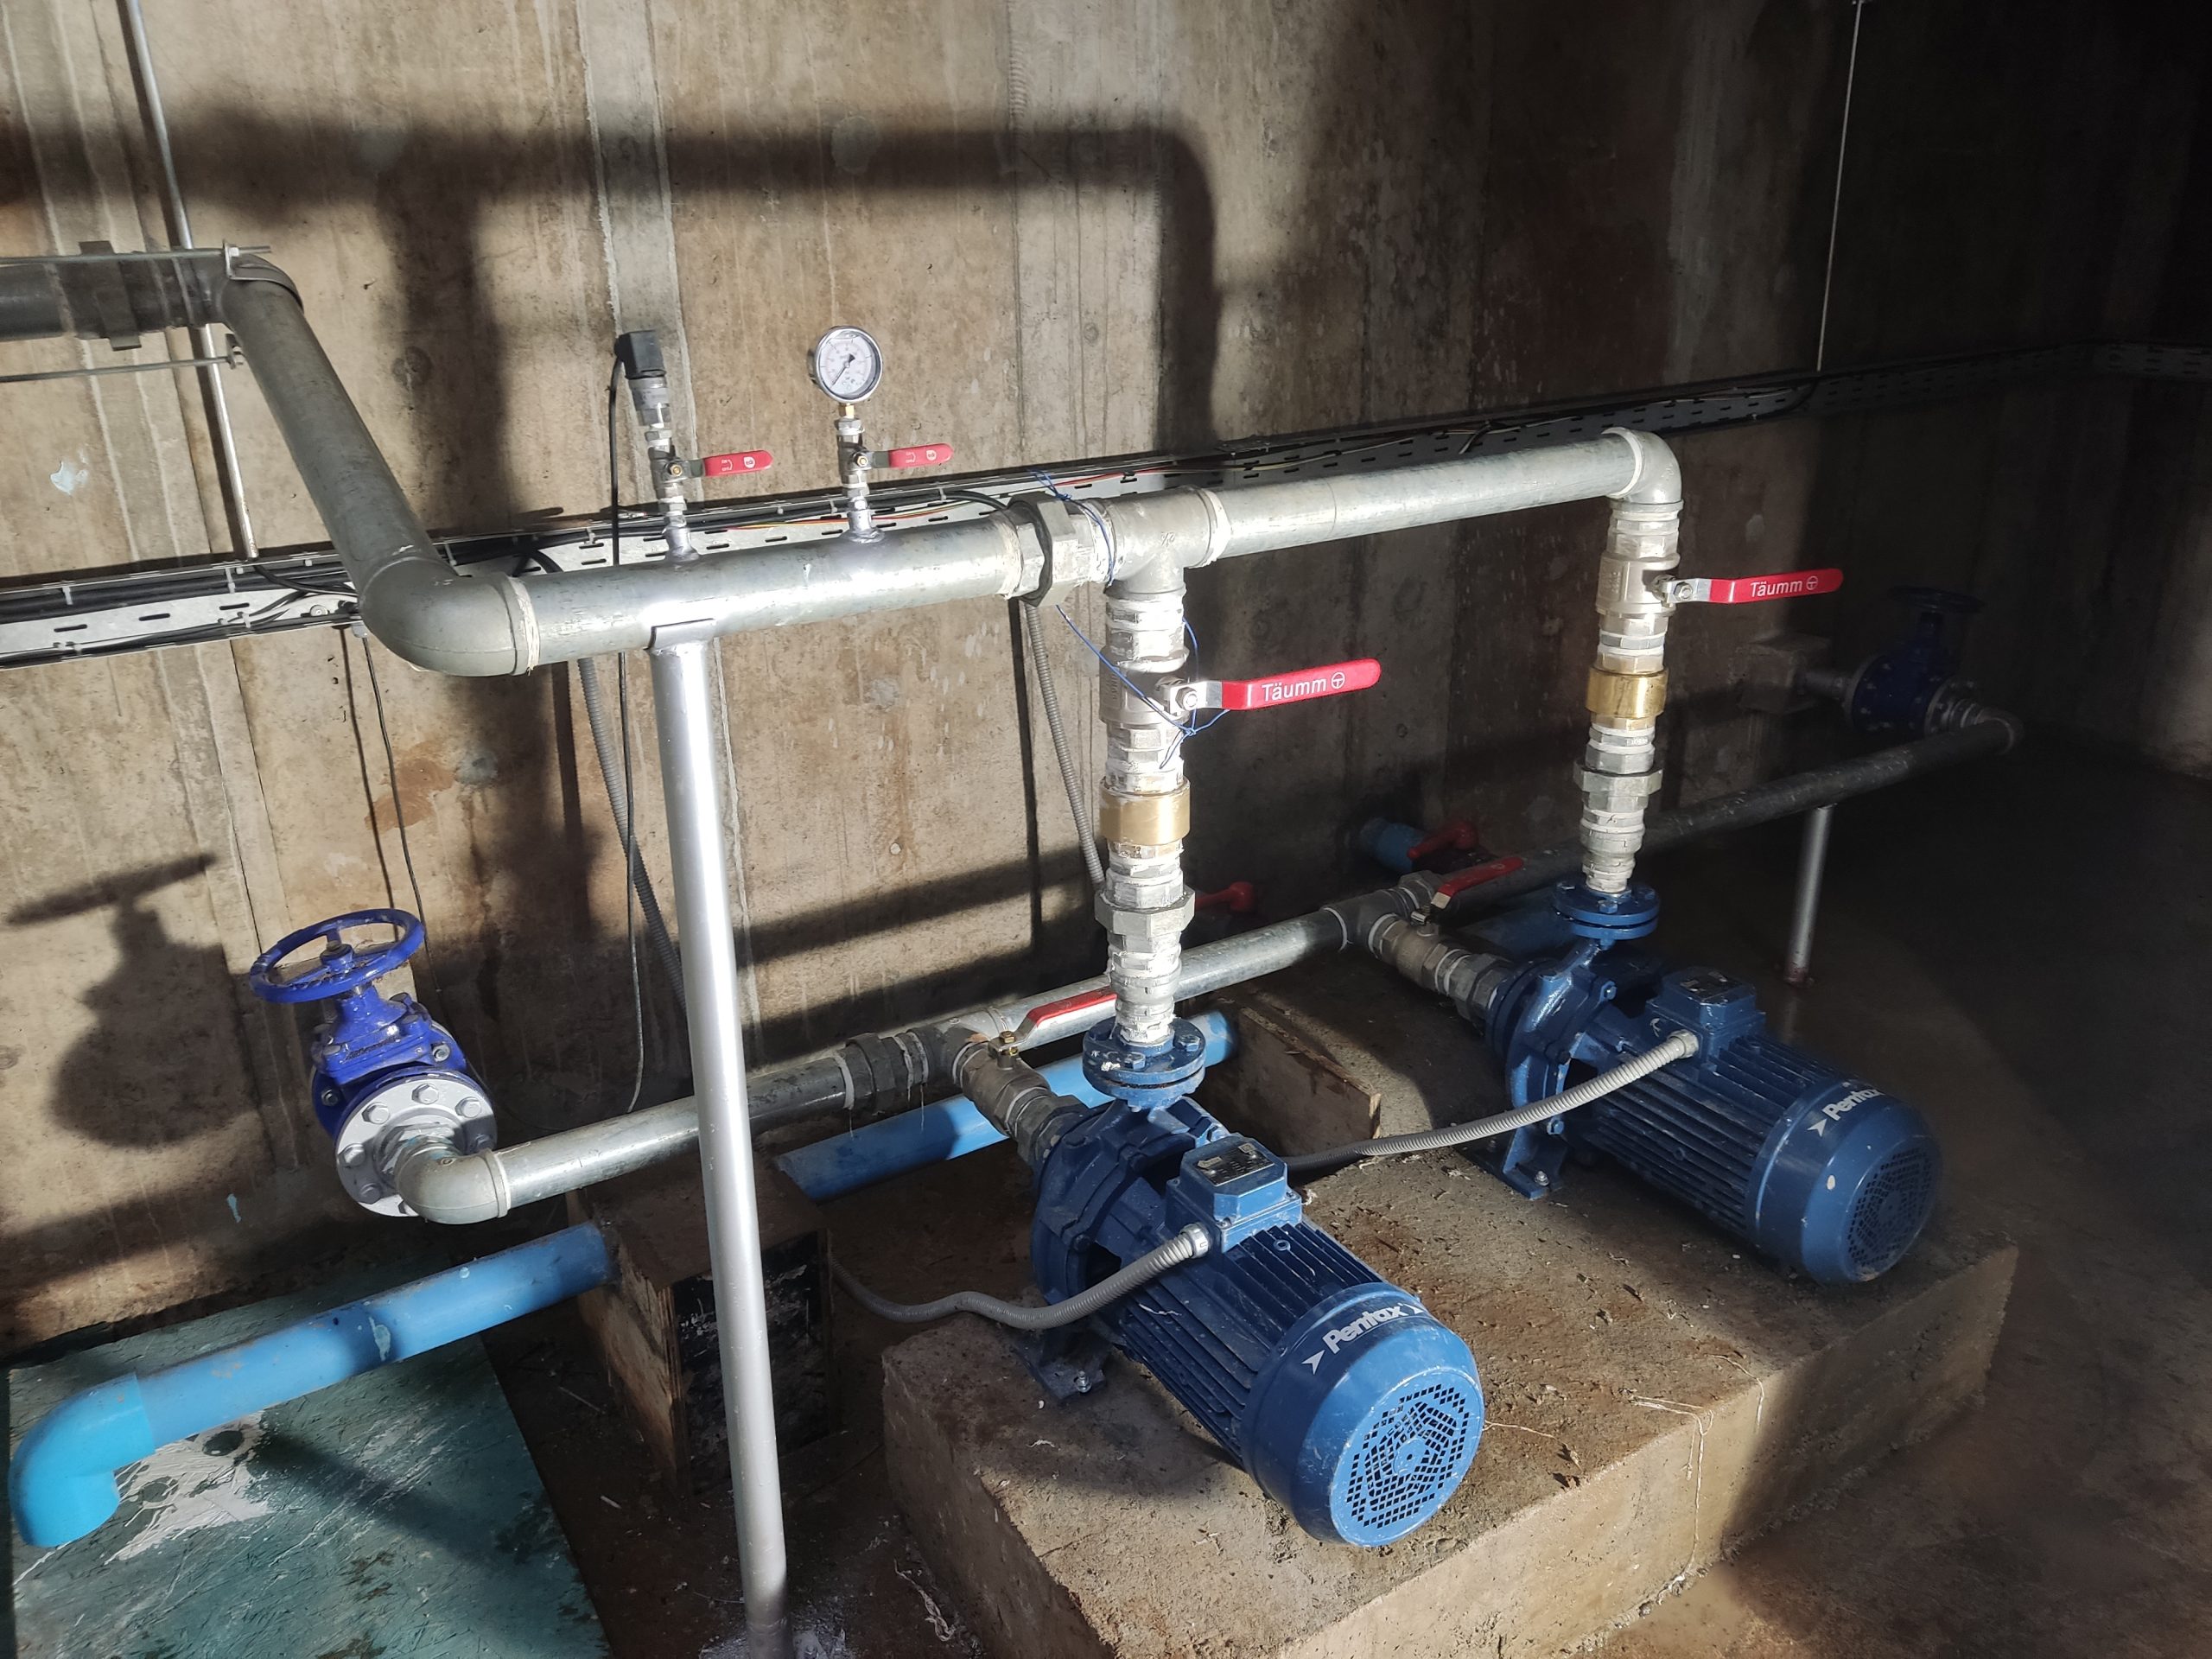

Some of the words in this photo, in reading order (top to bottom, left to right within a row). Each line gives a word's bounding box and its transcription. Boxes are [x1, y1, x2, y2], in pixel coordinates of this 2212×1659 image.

[1750, 581, 1802, 597] Täumm
[1262, 678, 1326, 702] Täumm
[1321, 1303, 1408, 1354] Pentax
